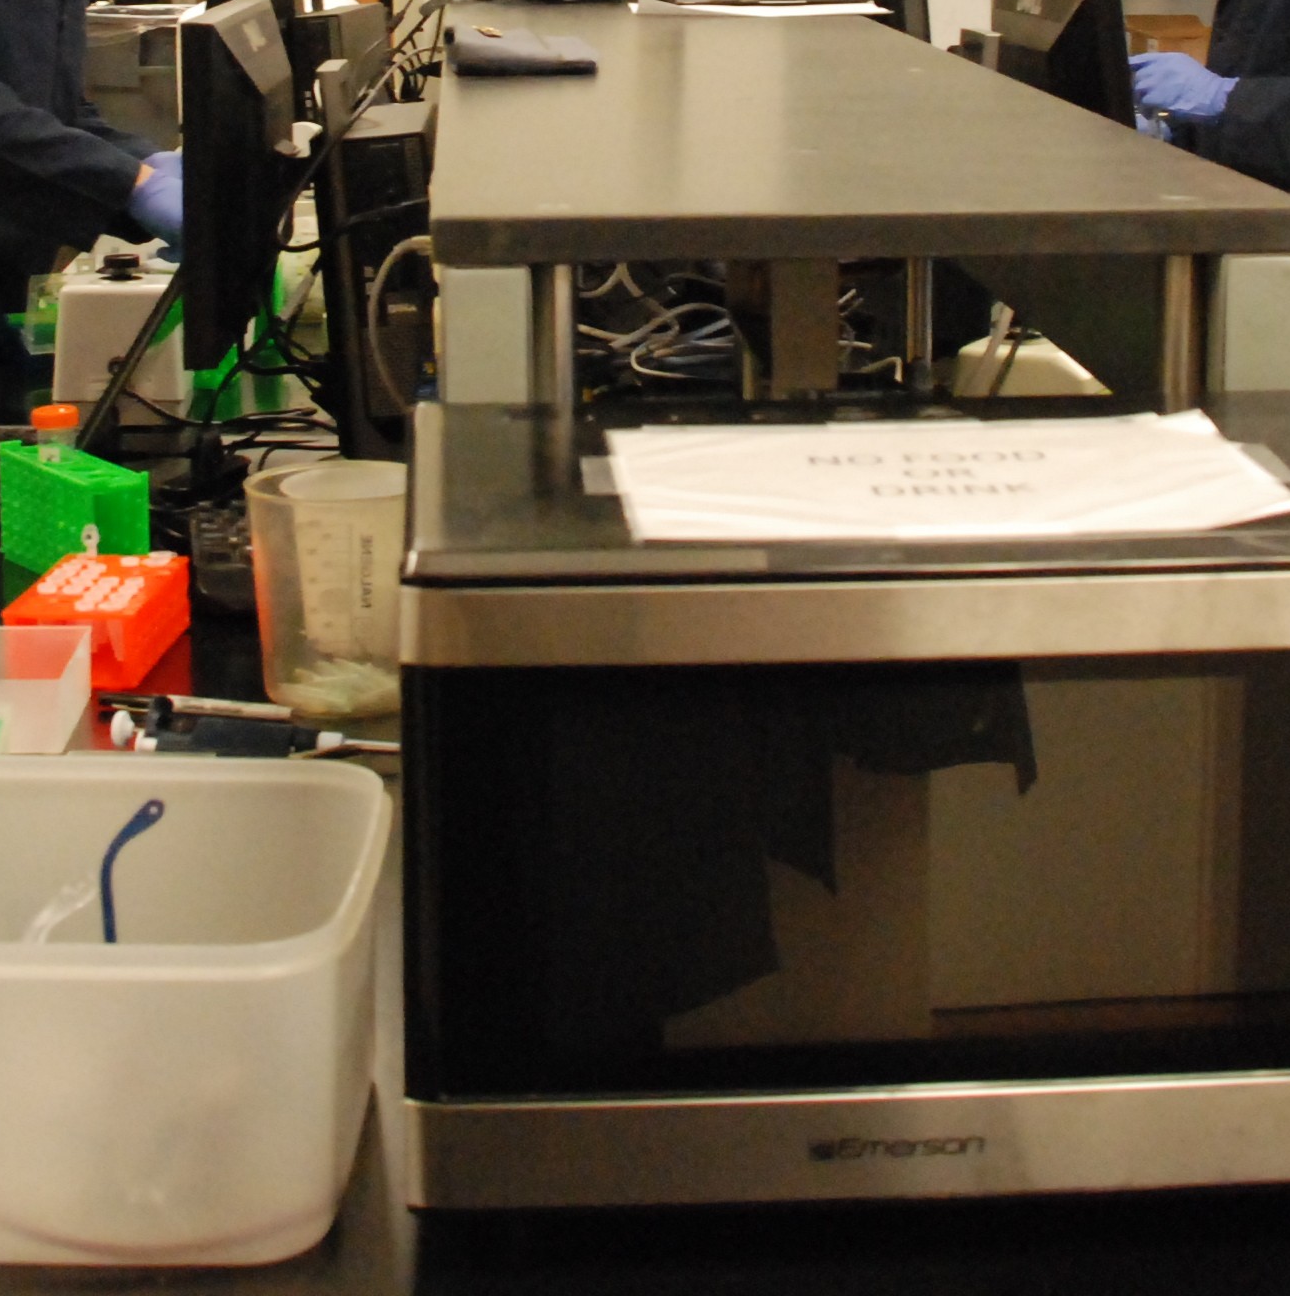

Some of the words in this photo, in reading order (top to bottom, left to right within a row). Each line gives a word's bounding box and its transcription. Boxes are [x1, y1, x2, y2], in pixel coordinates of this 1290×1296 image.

[807, 454, 884, 467] NO
[902, 450, 1047, 464] FOOD
[902, 466, 977, 479] OR
[870, 482, 1038, 497] DRINK
[839, 1136, 986, 1158] Emerson
